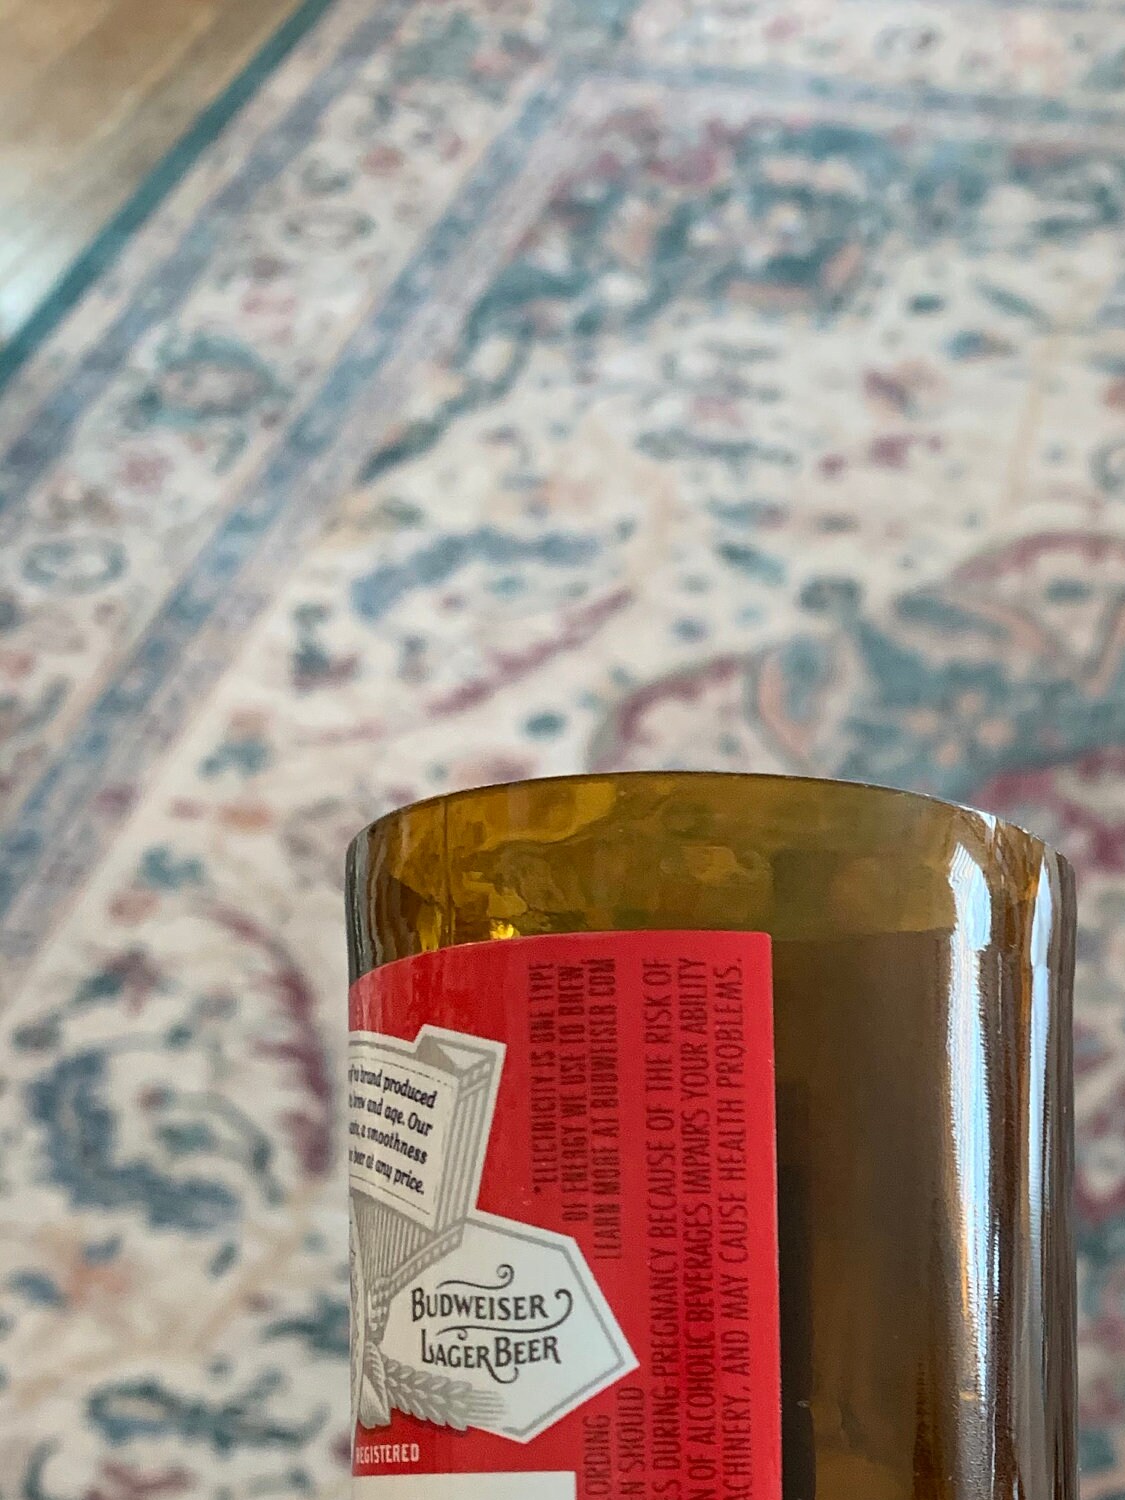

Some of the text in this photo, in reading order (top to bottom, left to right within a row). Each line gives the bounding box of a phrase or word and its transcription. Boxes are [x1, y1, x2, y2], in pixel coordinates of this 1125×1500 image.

[530, 963, 555, 1001] TYPE
[644, 959, 673, 986] OF
[645, 995, 673, 1045] RISK
[679, 958, 709, 1036] ABILITY
[560, 1024, 586, 1044] TO
[715, 958, 746, 1089] PROBLEMS.
[561, 1053, 587, 1086] USE
[645, 1055, 674, 1093] THE
[681, 1042, 710, 1102] YOUR
[383, 1079, 438, 1109] produced
[407, 1112, 433, 1137] Our
[592, 1118, 620, 1138] AT
[646, 1103, 675, 1132] OF
[718, 1100, 748, 1181] HEALTH
[367, 1126, 428, 1165] smoothness
[682, 1109, 713, 1195] IMPAIRS
[393, 1169, 424, 1195] price.
[648, 1141, 678, 1240] BECAUSE
[719, 1195, 749, 1264] CAUSE
[683, 1202, 715, 1324] BEVERAGES
[411, 1286, 550, 1322] BUDWEISER
[650, 1248, 680, 1377] PREGNANCY
[721, 1274, 750, 1321] MAY
[421, 1328, 562, 1376] LAGER BEER
[722, 1330, 752, 1376] AND
[685, 1328, 717, 1445] ALCOHOLIC
[618, 1386, 646, 1473] SHOULD
[652, 1386, 681, 1471] DURING
[355, 1442, 420, 1465] REGISTERED
[687, 1454, 718, 1481] OF
